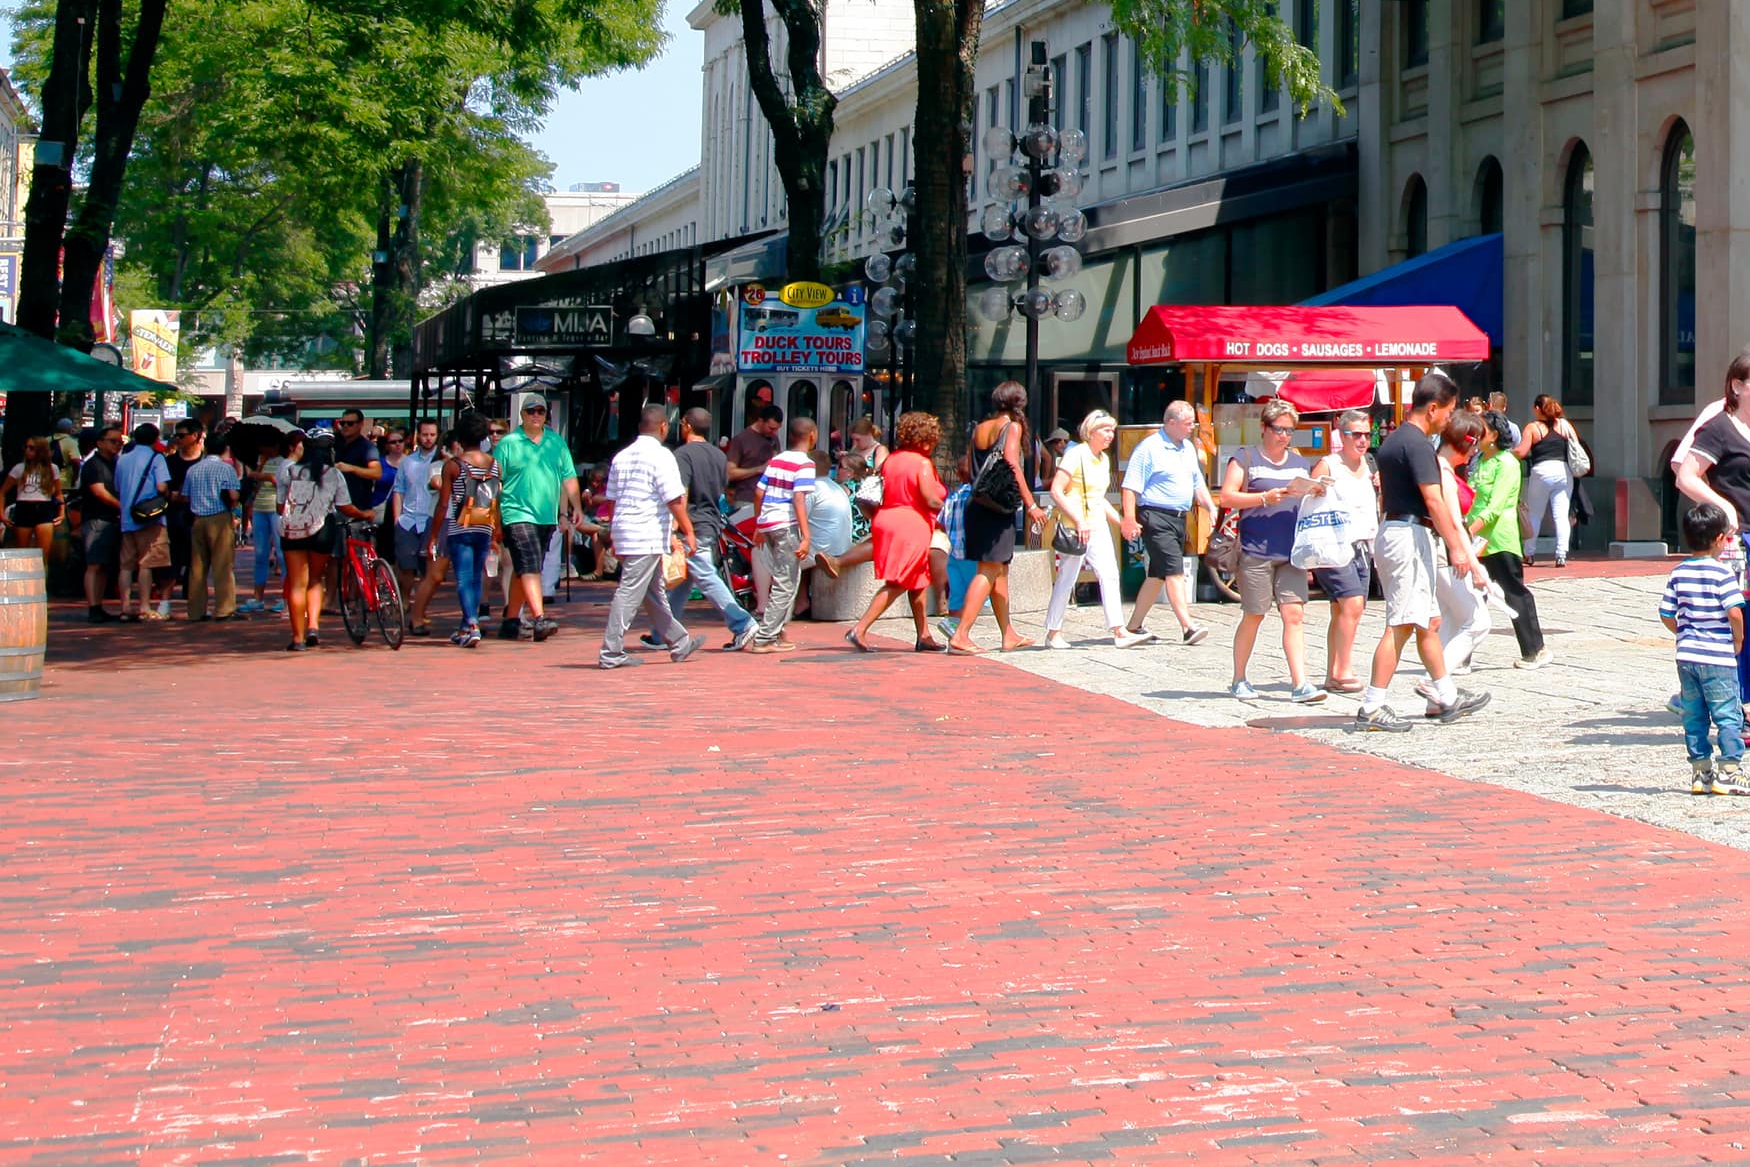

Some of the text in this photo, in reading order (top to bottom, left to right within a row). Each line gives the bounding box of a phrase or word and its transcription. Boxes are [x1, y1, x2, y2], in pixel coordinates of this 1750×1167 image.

[754, 335, 853, 350] DUCK TOURS
[1226, 342, 1437, 356] HOT DOGS SAUSAGES LEMONADE
[741, 350, 862, 365] TROLLEY TOURS
